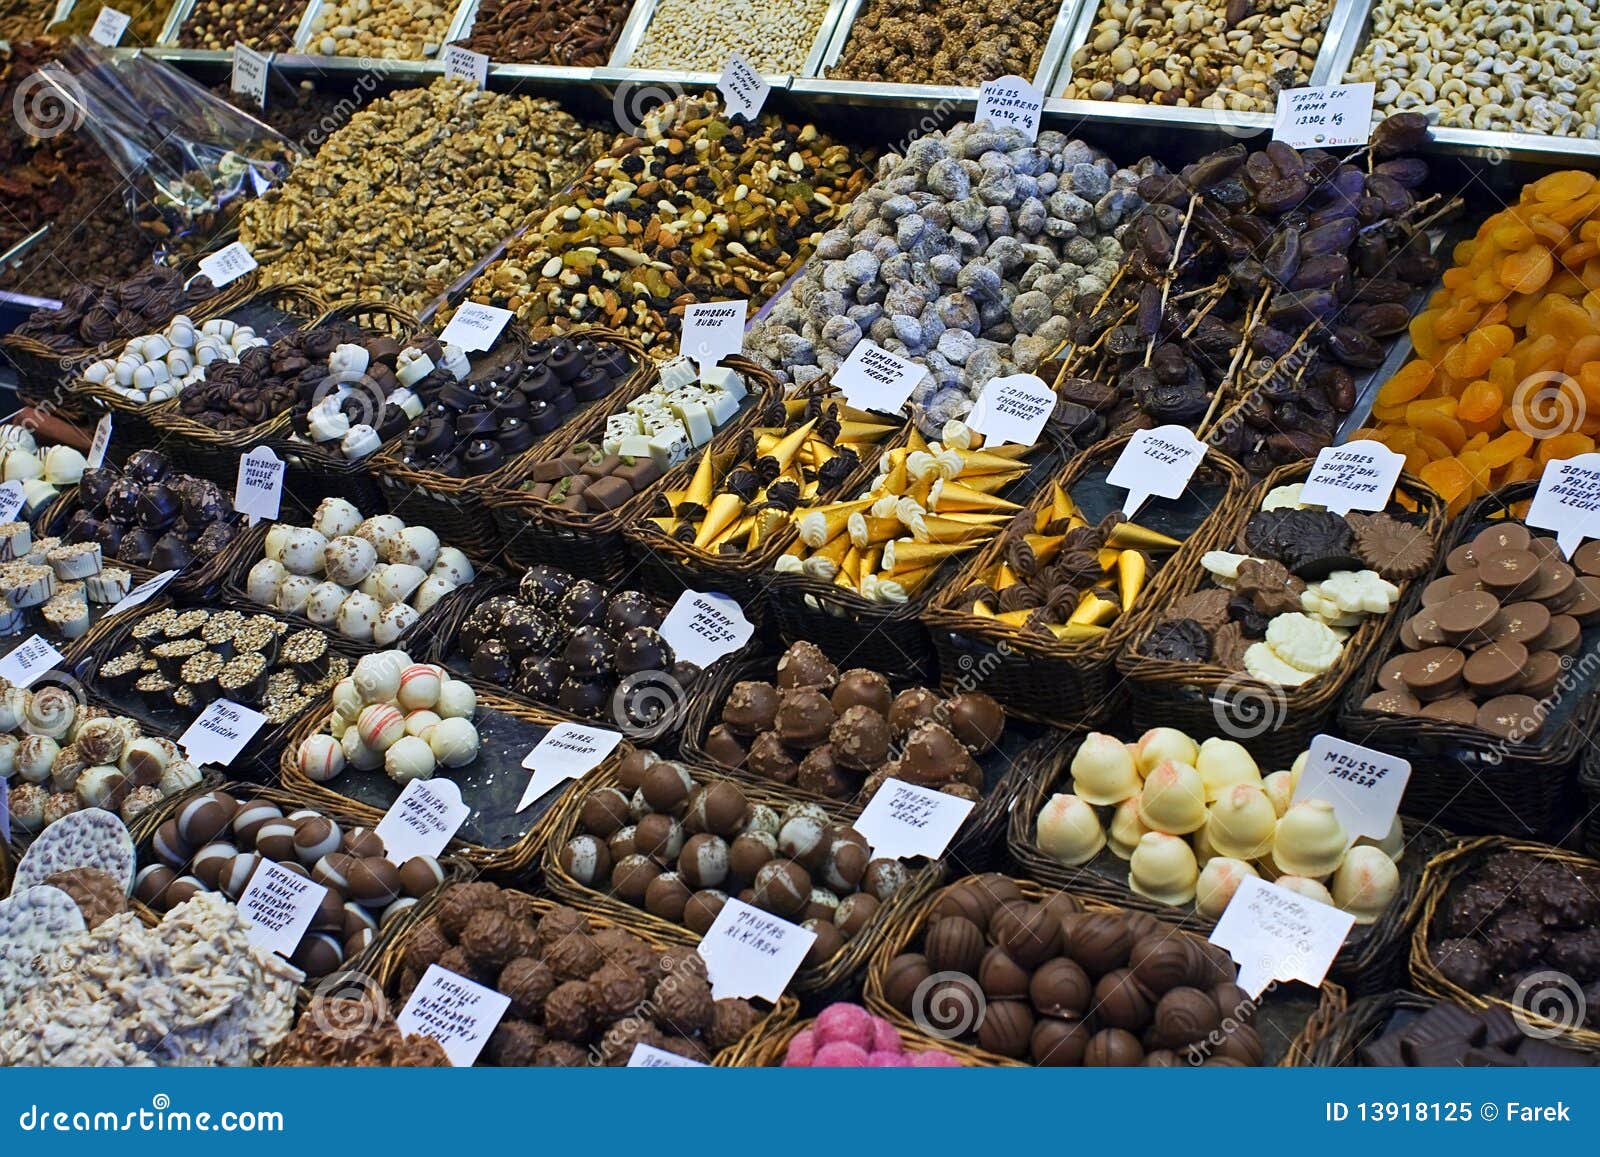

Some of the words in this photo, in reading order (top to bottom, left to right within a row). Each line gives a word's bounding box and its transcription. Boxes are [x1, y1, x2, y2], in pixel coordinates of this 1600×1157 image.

[984, 85, 1019, 98] HIGOS
[1330, 90, 1347, 99] EN
[986, 97, 1039, 111] PAJARERO
[1294, 102, 1328, 112] RAMA
[693, 308, 737, 318] BOMBONES
[864, 348, 904, 370] BOMBON
[863, 367, 895, 385] NEGRO
[996, 395, 1046, 416] CHOCOLATE
[1143, 447, 1178, 465] LECHE
[1331, 451, 1375, 464] FLORES
[1311, 474, 1379, 494] CHOCOLATE
[1338, 473, 1354, 481] DE
[688, 621, 721, 643] COCO
[693, 613, 736, 642] MOUSSE
[1323, 751, 1390, 779] MOUSSE
[1328, 766, 1377, 789] FRESA
[890, 810, 930, 828] LECHE
[247, 899, 296, 926] CHOCOLATE
[252, 912, 284, 932] BLANCO
